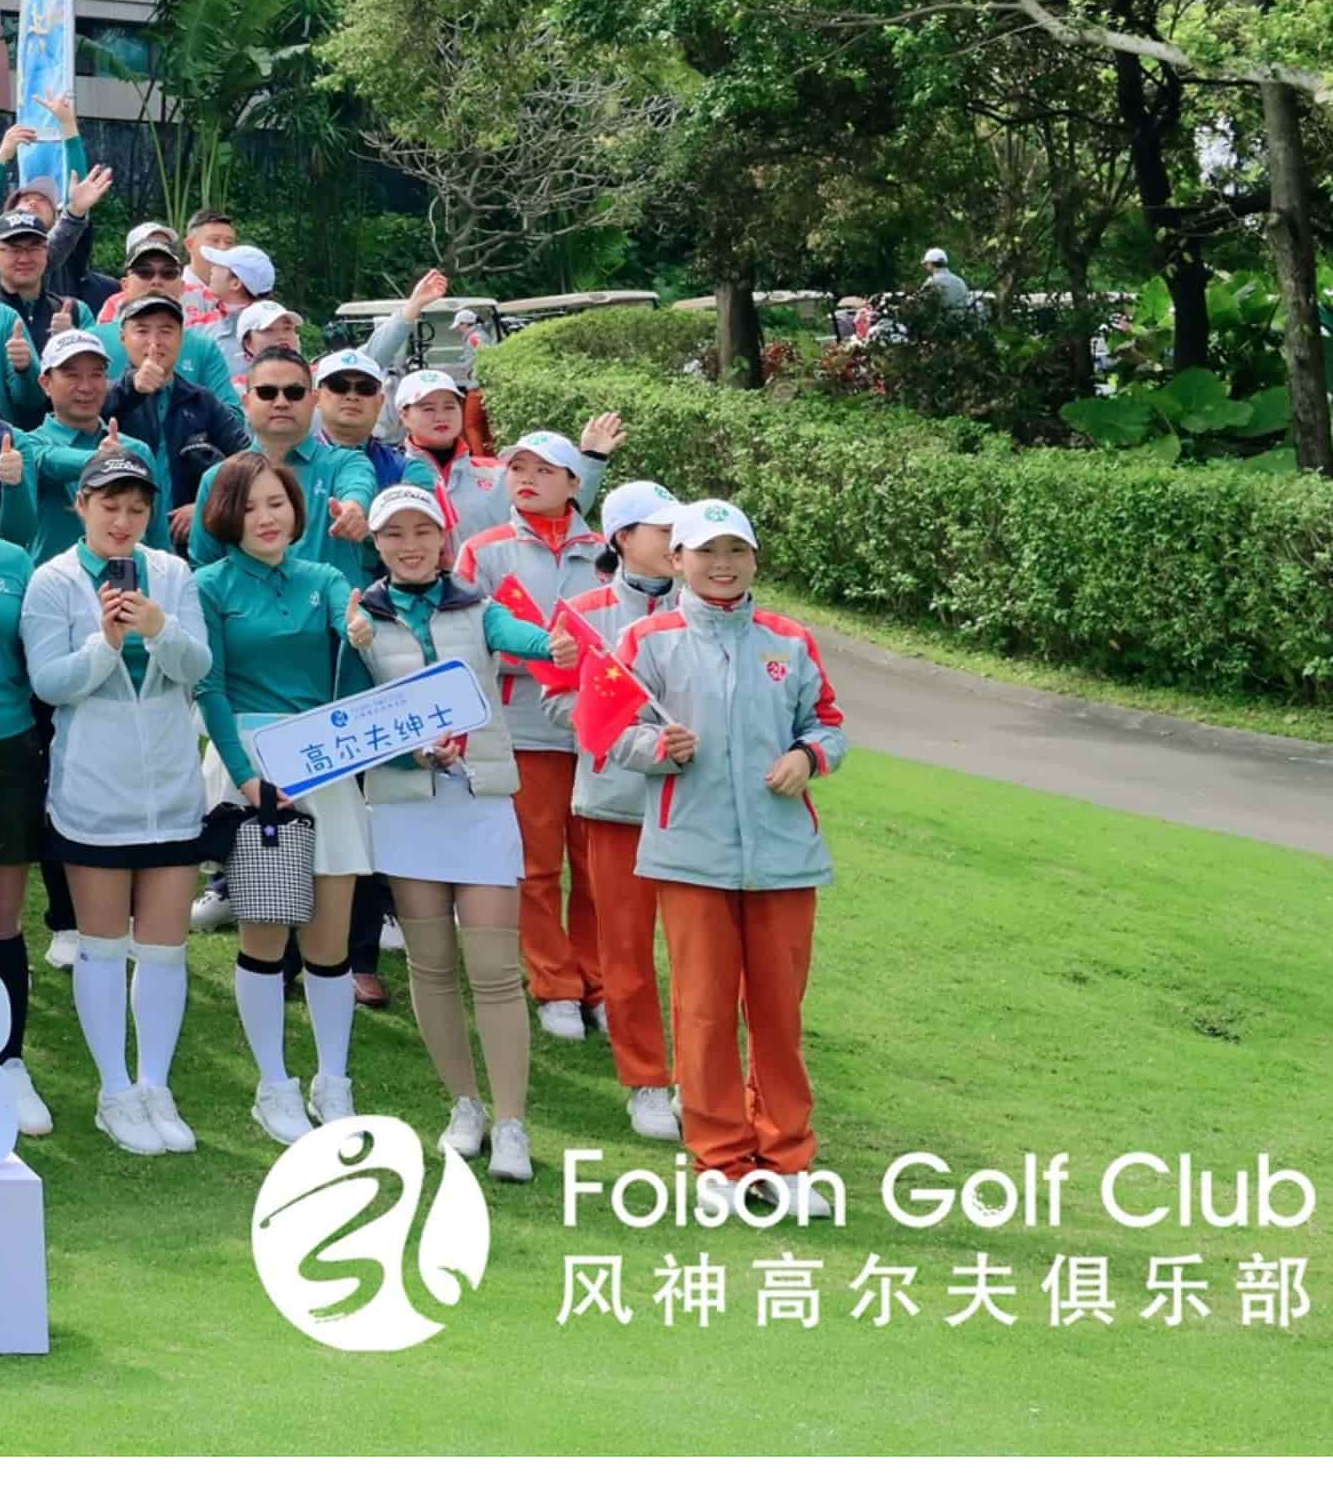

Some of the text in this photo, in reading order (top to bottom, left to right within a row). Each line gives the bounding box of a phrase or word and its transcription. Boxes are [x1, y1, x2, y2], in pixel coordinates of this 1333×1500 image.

[299, 703, 454, 775] 高尔夫绅士
